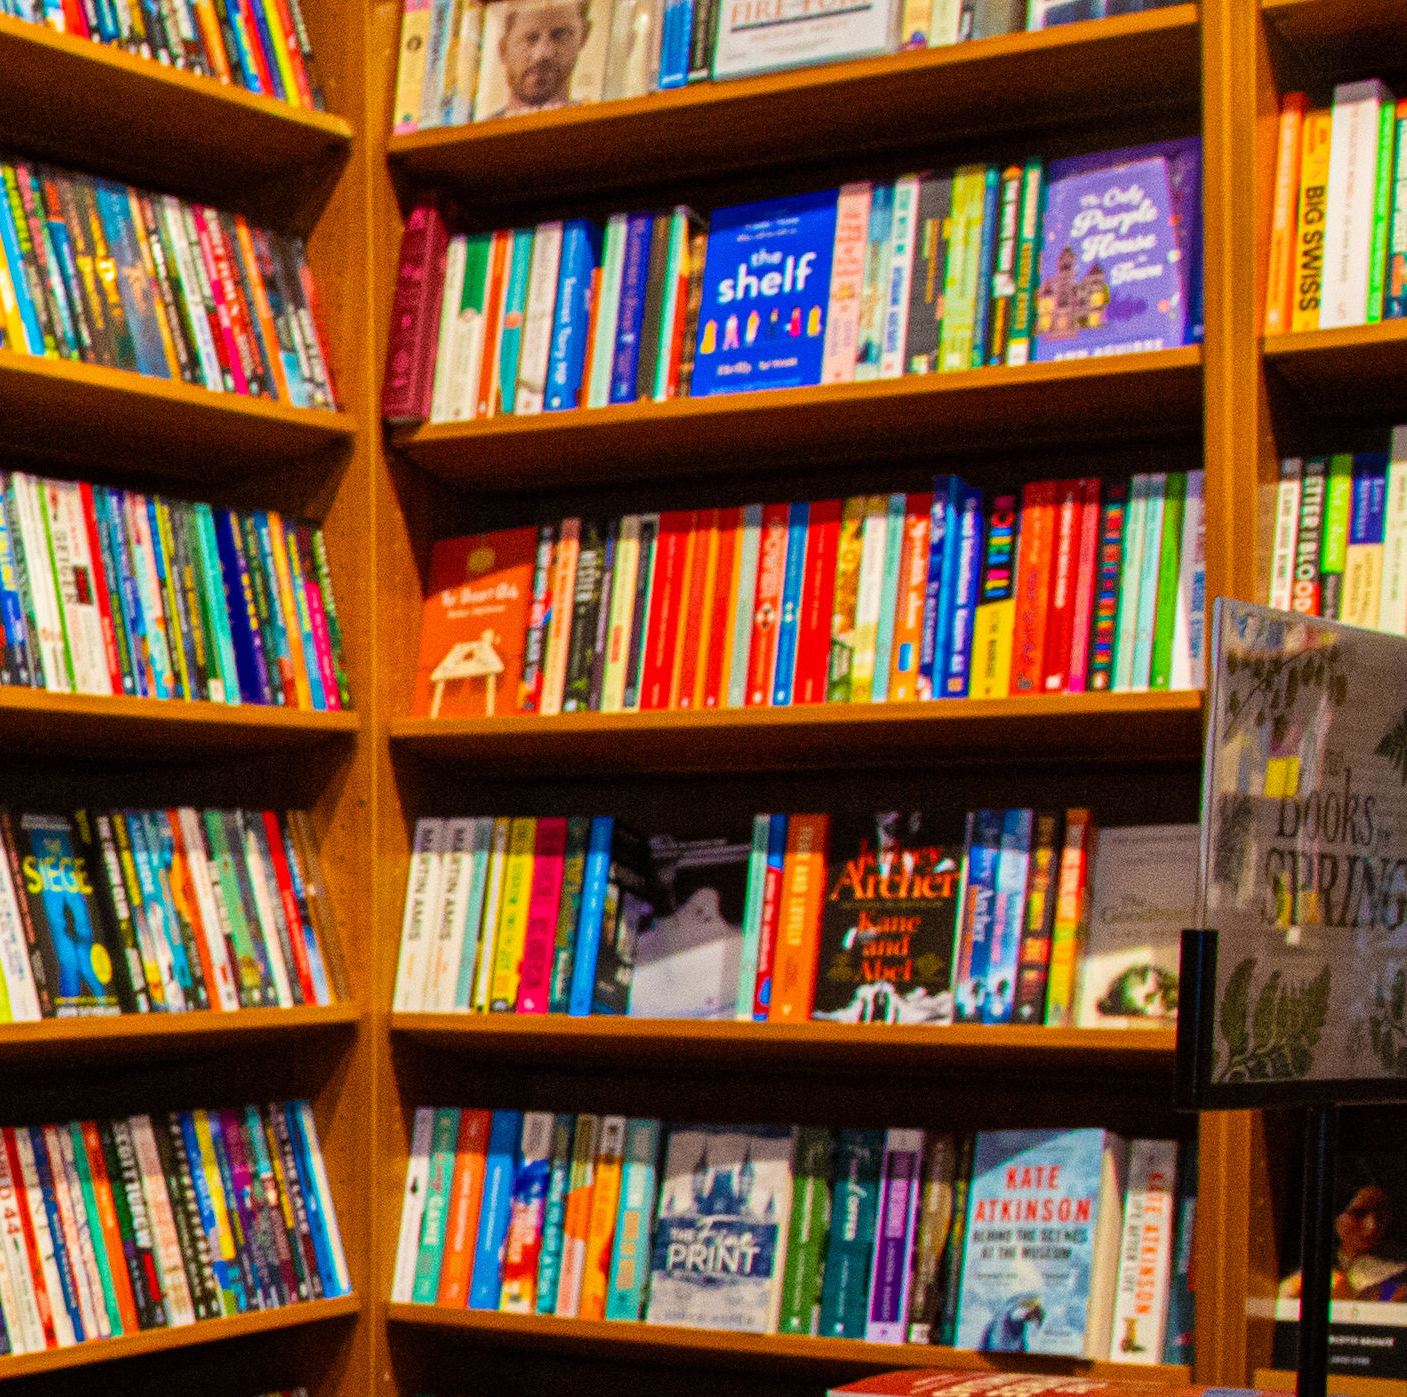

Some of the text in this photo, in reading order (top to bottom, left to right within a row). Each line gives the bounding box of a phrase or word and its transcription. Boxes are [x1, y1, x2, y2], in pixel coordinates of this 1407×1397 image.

[1299, 185, 1325, 312] BIG SWISS
[717, 252, 816, 304] shelf
[22, 856, 93, 895] SIEGE
[831, 860, 962, 900] Archer
[1006, 1164, 1060, 1190] KATE
[974, 1198, 1091, 1222] ATKINSON
[666, 1244, 759, 1274] PRINT
